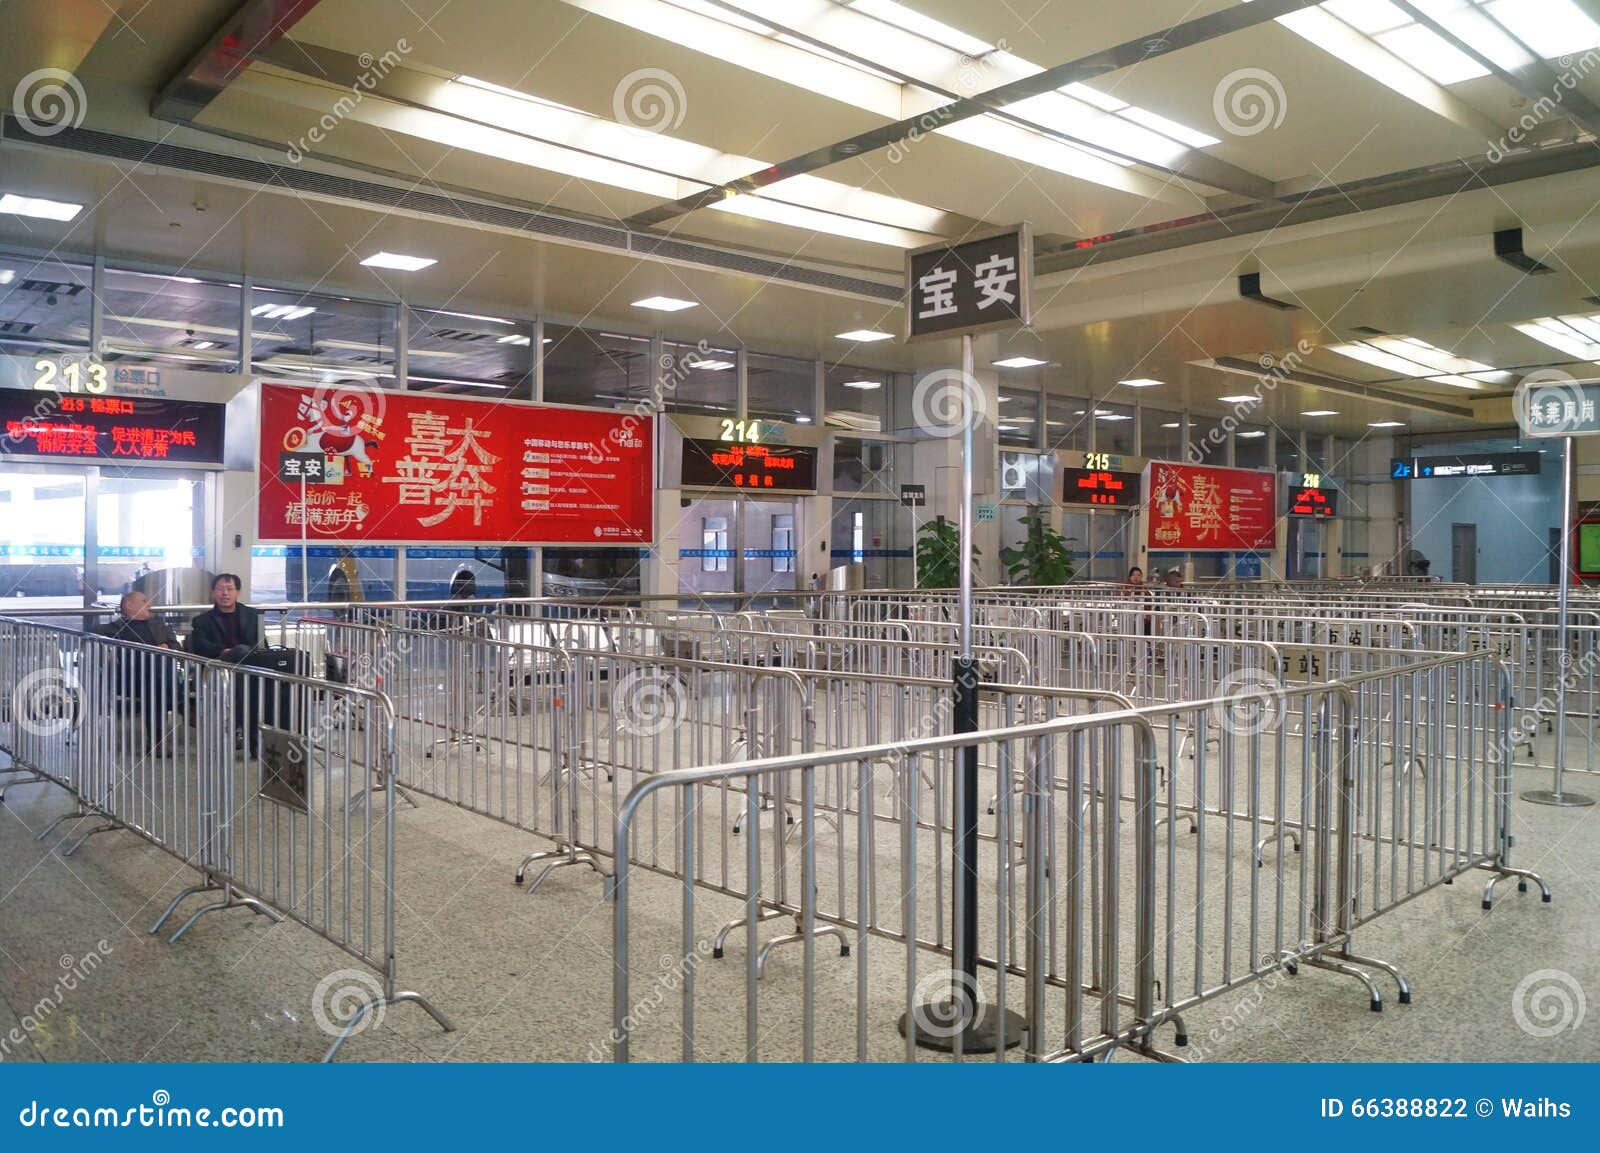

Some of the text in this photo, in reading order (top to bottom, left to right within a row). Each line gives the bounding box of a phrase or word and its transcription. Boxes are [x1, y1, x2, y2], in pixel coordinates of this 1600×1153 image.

[919, 254, 1017, 319] 宝安
[34, 360, 107, 393] 213
[721, 418, 759, 443] 214
[284, 458, 322, 477] 宝安
[1086, 453, 1109, 470] 215
[1393, 461, 1411, 477] 2F
